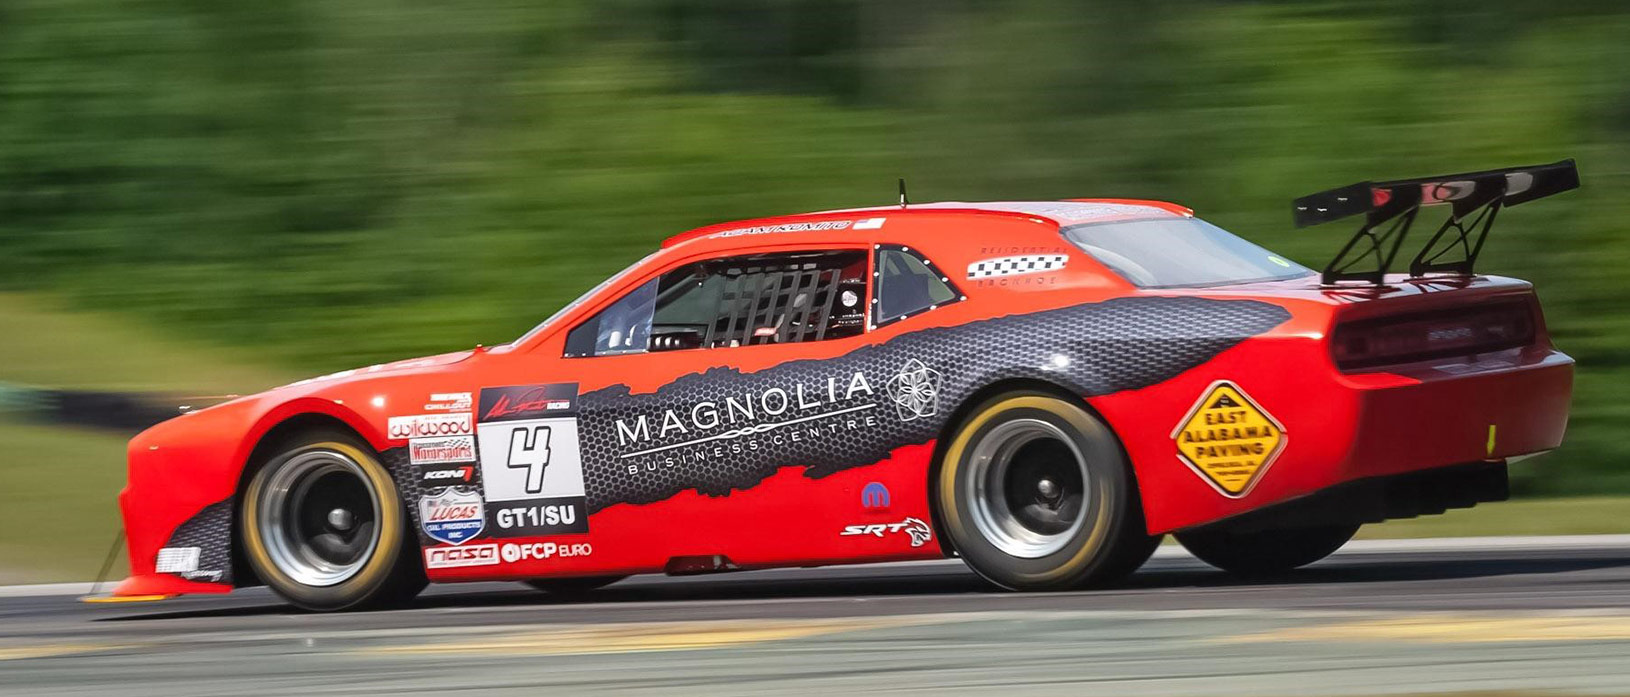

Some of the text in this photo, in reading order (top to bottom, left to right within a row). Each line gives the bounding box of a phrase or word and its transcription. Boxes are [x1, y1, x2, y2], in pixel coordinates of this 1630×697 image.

[614, 372, 874, 446] MAGNOLIA
[1204, 410, 1247, 425] EAST
[1183, 426, 1273, 443] ALABAMA
[627, 415, 877, 475] BUSINESS CENTRE
[1195, 442, 1265, 459] PAVING
[507, 426, 551, 494] 4
[430, 506, 478, 521] LUCAS
[496, 505, 576, 529] GT1/SU
[840, 523, 908, 537] SRT
[520, 542, 592, 559] FCP EURO
